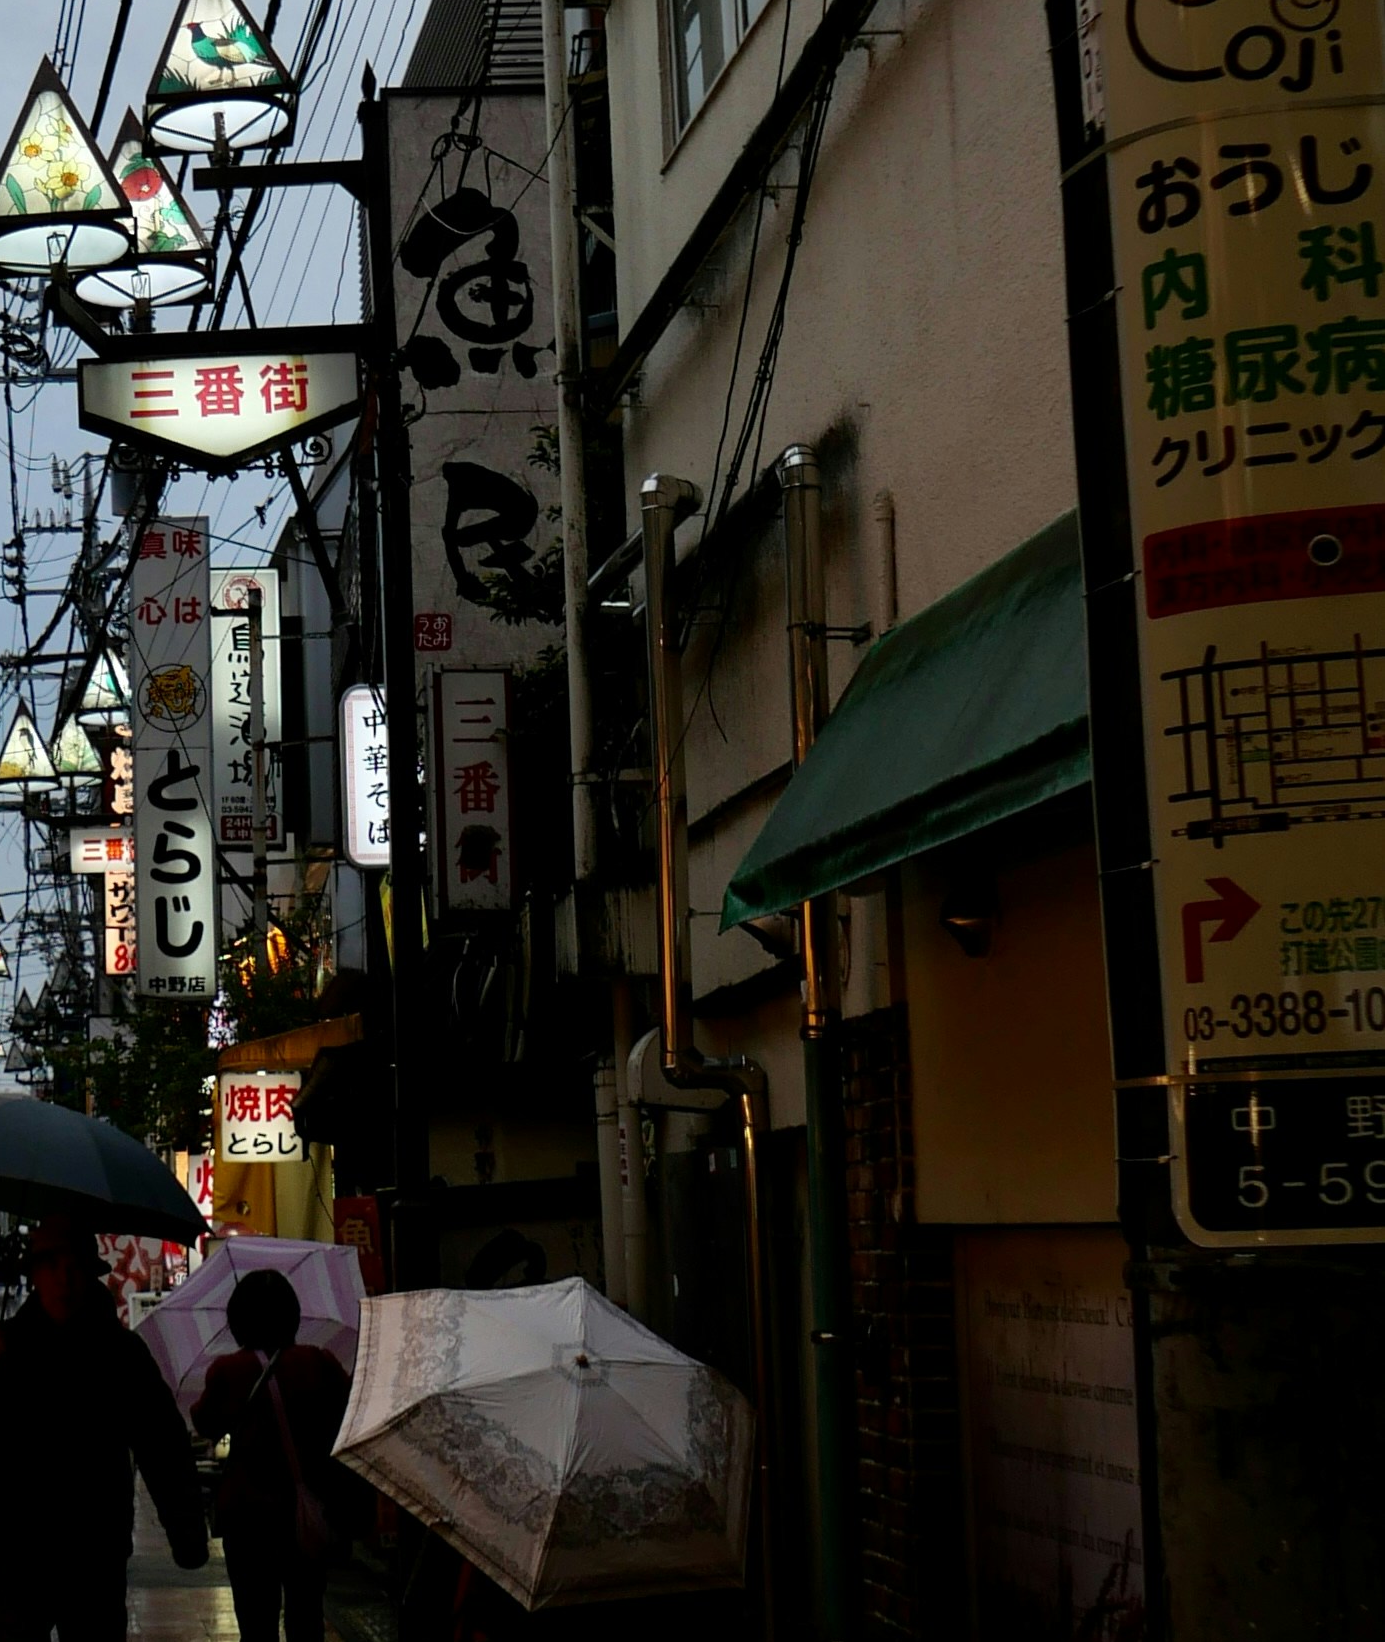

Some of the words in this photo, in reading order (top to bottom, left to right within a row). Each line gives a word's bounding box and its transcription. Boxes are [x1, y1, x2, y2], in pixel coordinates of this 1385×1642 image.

[1136, 135, 1373, 234] おうじ
[1142, 221, 1385, 330] 内科
[130, 362, 309, 419] 三番街
[399, 186, 556, 612] 魚民
[1146, 316, 1385, 421] 糖尿病
[1152, 409, 1385, 487] クリニック
[362, 708, 390, 845] 中華そば
[147, 749, 205, 959] とらじ
[1279, 896, 1385, 934] この先27
[149, 975, 206, 994] 中野店
[1279, 936, 1385, 976] 打越公園
[225, 1084, 300, 1123] 焼肉
[227, 1131, 299, 1156] とらじ
